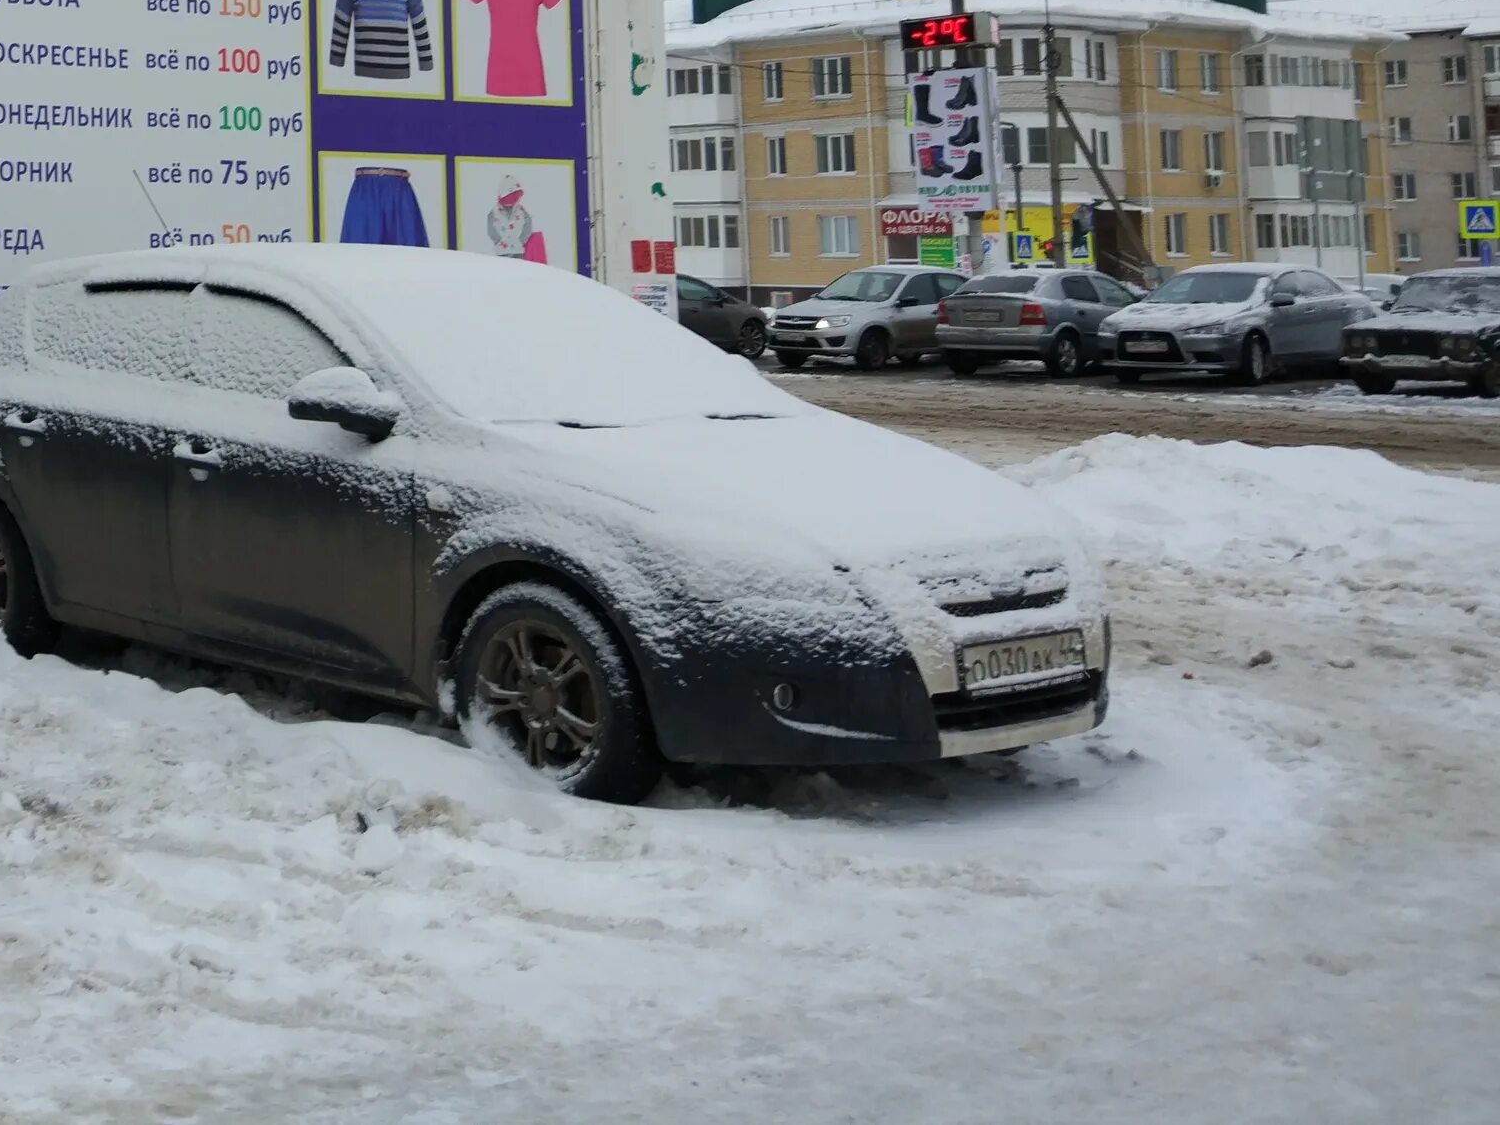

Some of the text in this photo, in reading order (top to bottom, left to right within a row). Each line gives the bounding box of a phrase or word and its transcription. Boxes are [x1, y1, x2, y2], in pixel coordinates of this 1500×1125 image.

[187, 0, 210, 14] по
[269, 1, 301, 24] руб
[147, 50, 178, 69] всё
[186, 56, 209, 71] по
[219, 49, 260, 73] 100
[268, 56, 300, 79] руб
[148, 108, 180, 128] всё
[188, 114, 211, 129] по
[220, 106, 261, 131] 100
[270, 113, 302, 136] руб
[149, 163, 181, 183] всё
[189, 169, 212, 183] по
[221, 160, 248, 184] 75
[257, 165, 289, 190] руб
[882, 209, 950, 224] ФЛОРА
[190, 234, 214, 246] по
[223, 224, 250, 243] 50
